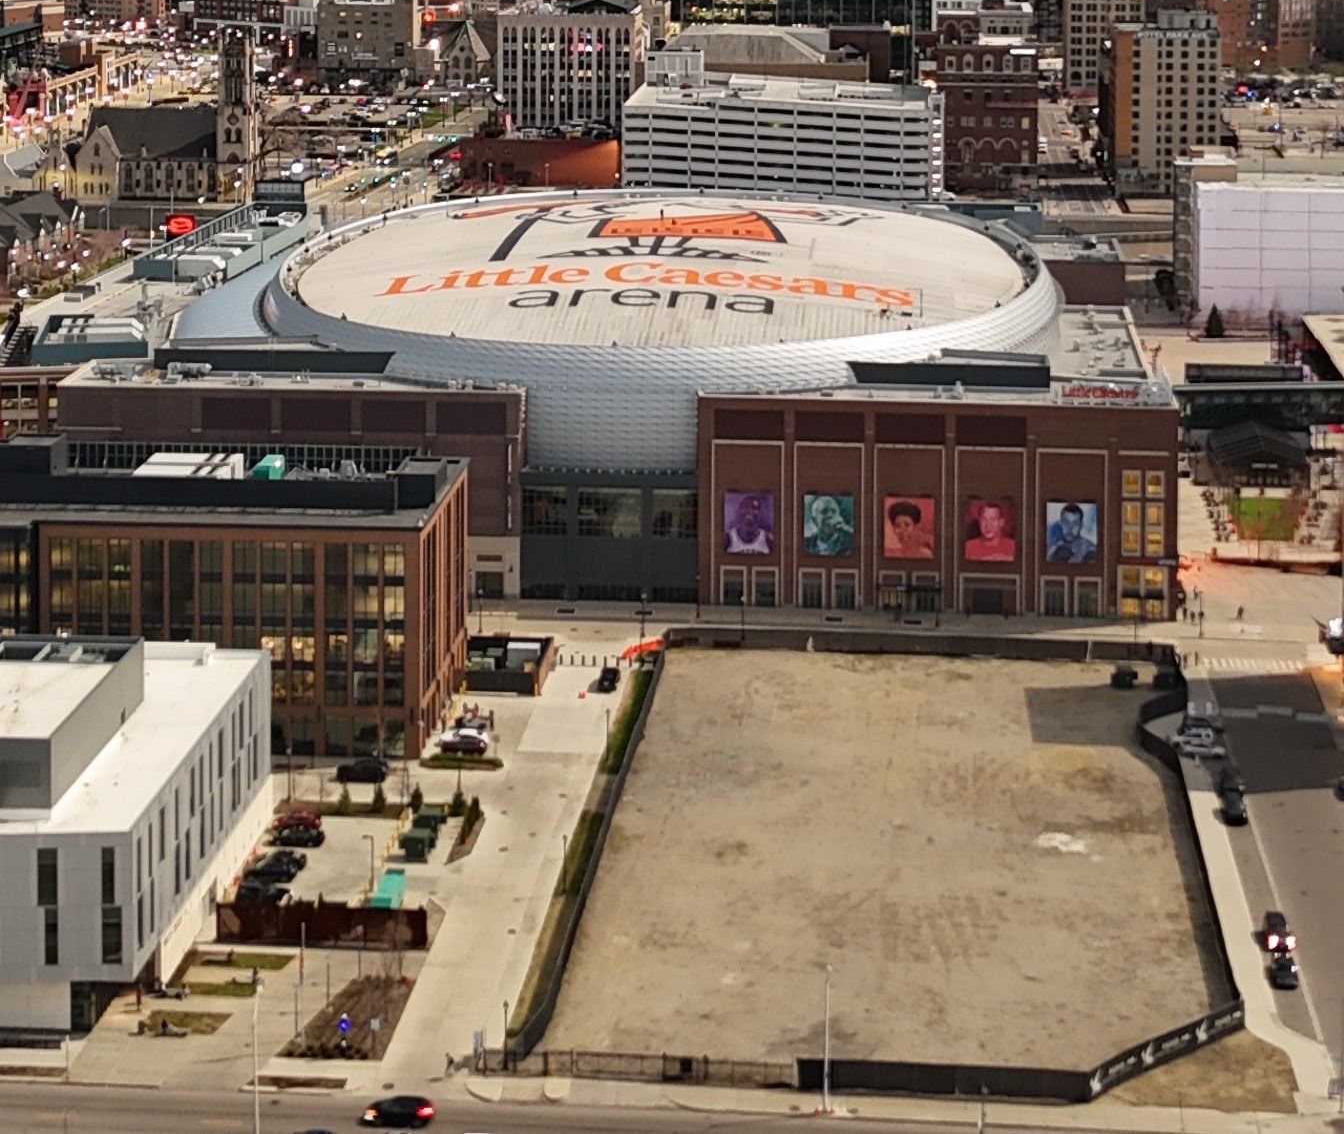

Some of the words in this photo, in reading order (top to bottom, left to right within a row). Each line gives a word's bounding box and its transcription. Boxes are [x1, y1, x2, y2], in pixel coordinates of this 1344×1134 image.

[372, 264, 595, 297] Little
[603, 261, 914, 307] Caesars
[508, 285, 775, 314] arena
